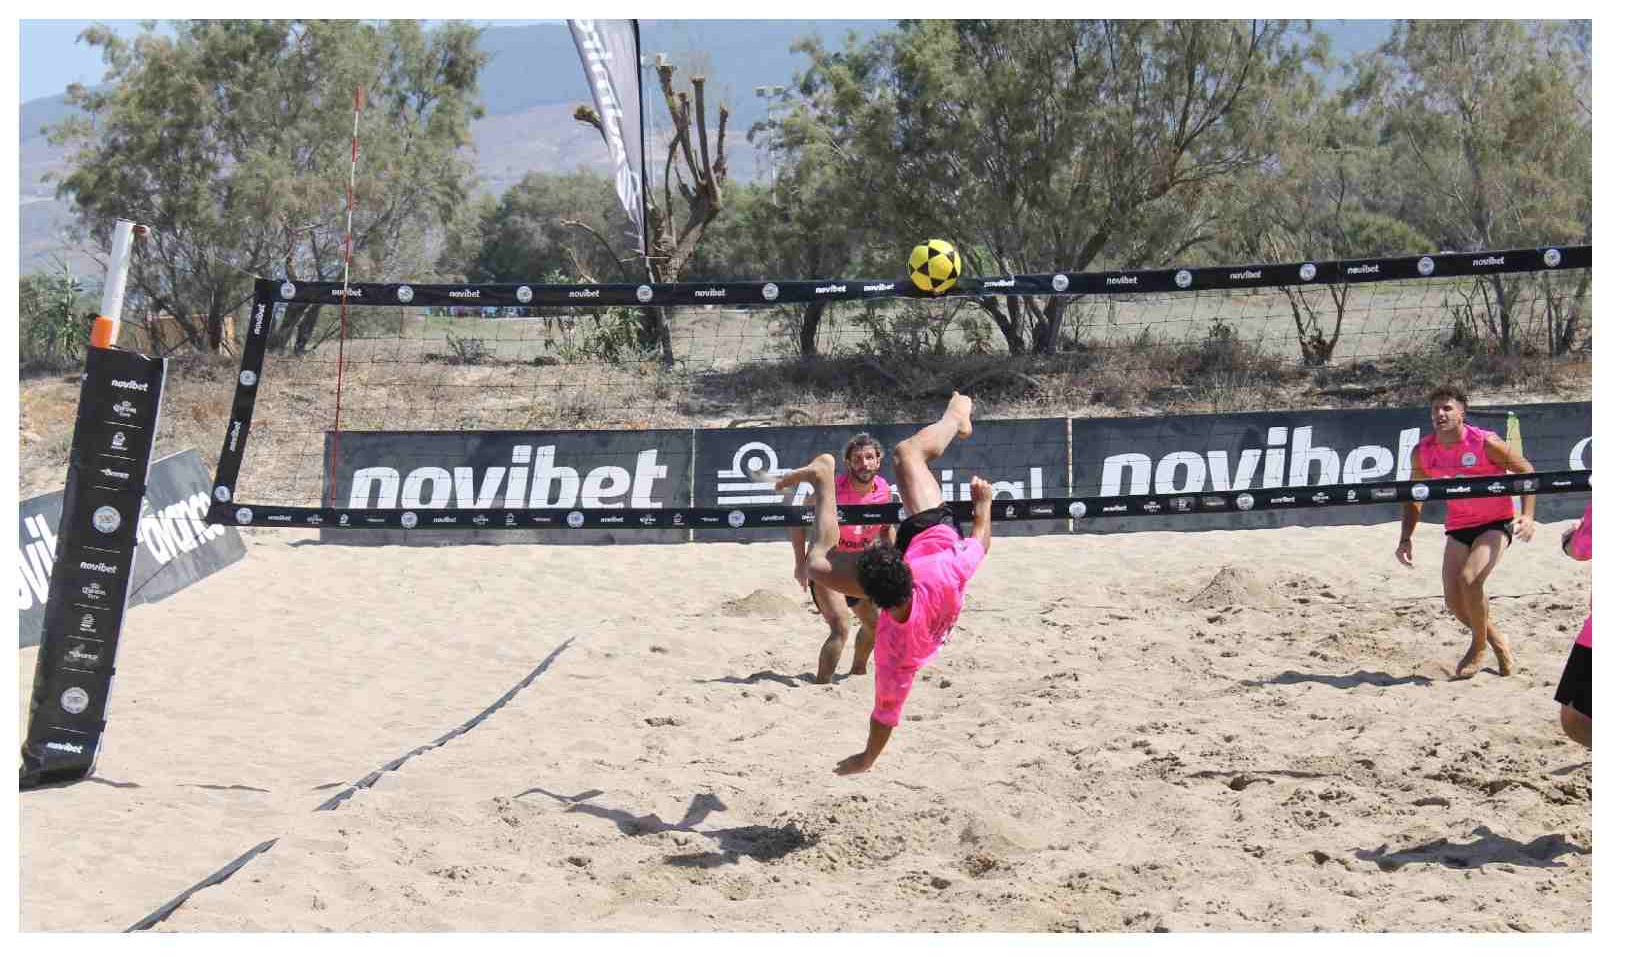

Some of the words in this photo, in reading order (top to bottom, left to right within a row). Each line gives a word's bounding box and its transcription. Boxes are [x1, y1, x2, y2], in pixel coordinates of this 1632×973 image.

[569, 289, 600, 298] novibet
[111, 378, 148, 392] novibet
[348, 444, 668, 509] novibet
[79, 561, 119, 574] novibet
